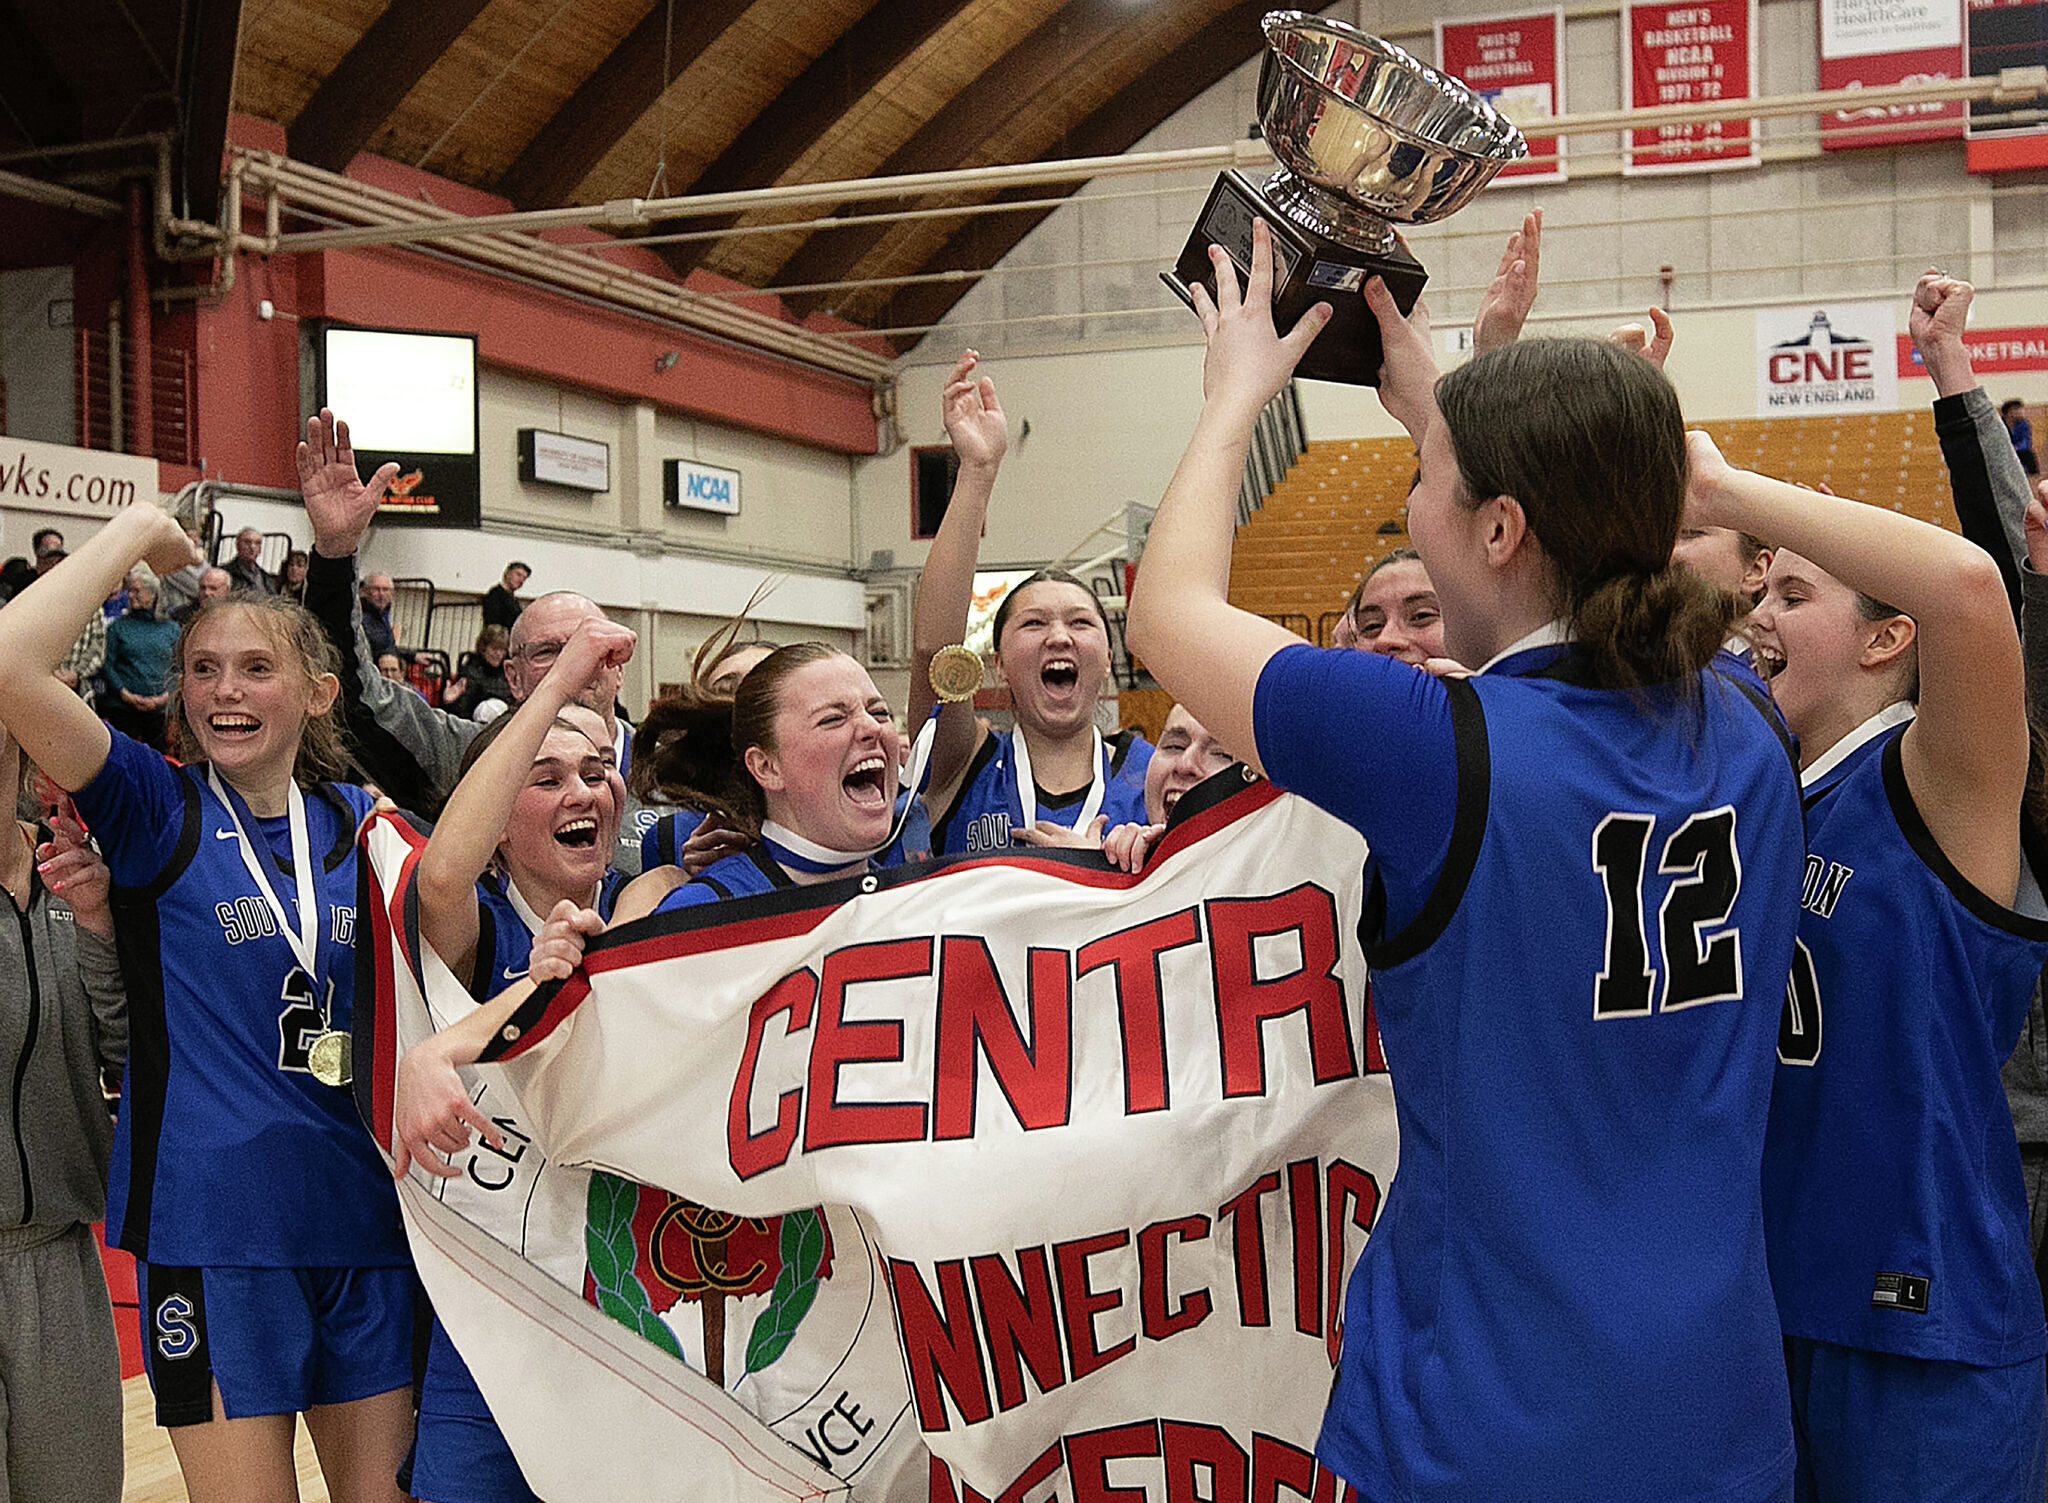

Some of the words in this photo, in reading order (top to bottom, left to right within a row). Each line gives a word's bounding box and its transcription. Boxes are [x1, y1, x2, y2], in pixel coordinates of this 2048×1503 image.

[1666, 8, 1711, 26] MEN'S
[1644, 25, 1733, 47] BASKETBALL
[1665, 45, 1714, 65] NCAA
[1966, 340, 2048, 361] KETBAL
[1769, 347, 1873, 384] CNE
[1769, 393, 1801, 405] NEW
[1805, 387, 1874, 404] ENGLAND
[687, 473, 730, 503] NCAA
[1592, 804, 1743, 1021] 12
[727, 882, 1392, 1182] CENTR
[873, 1156, 1382, 1433] NNECTIC
[1908, 1285, 1916, 1300] L
[157, 1293, 200, 1360] S
